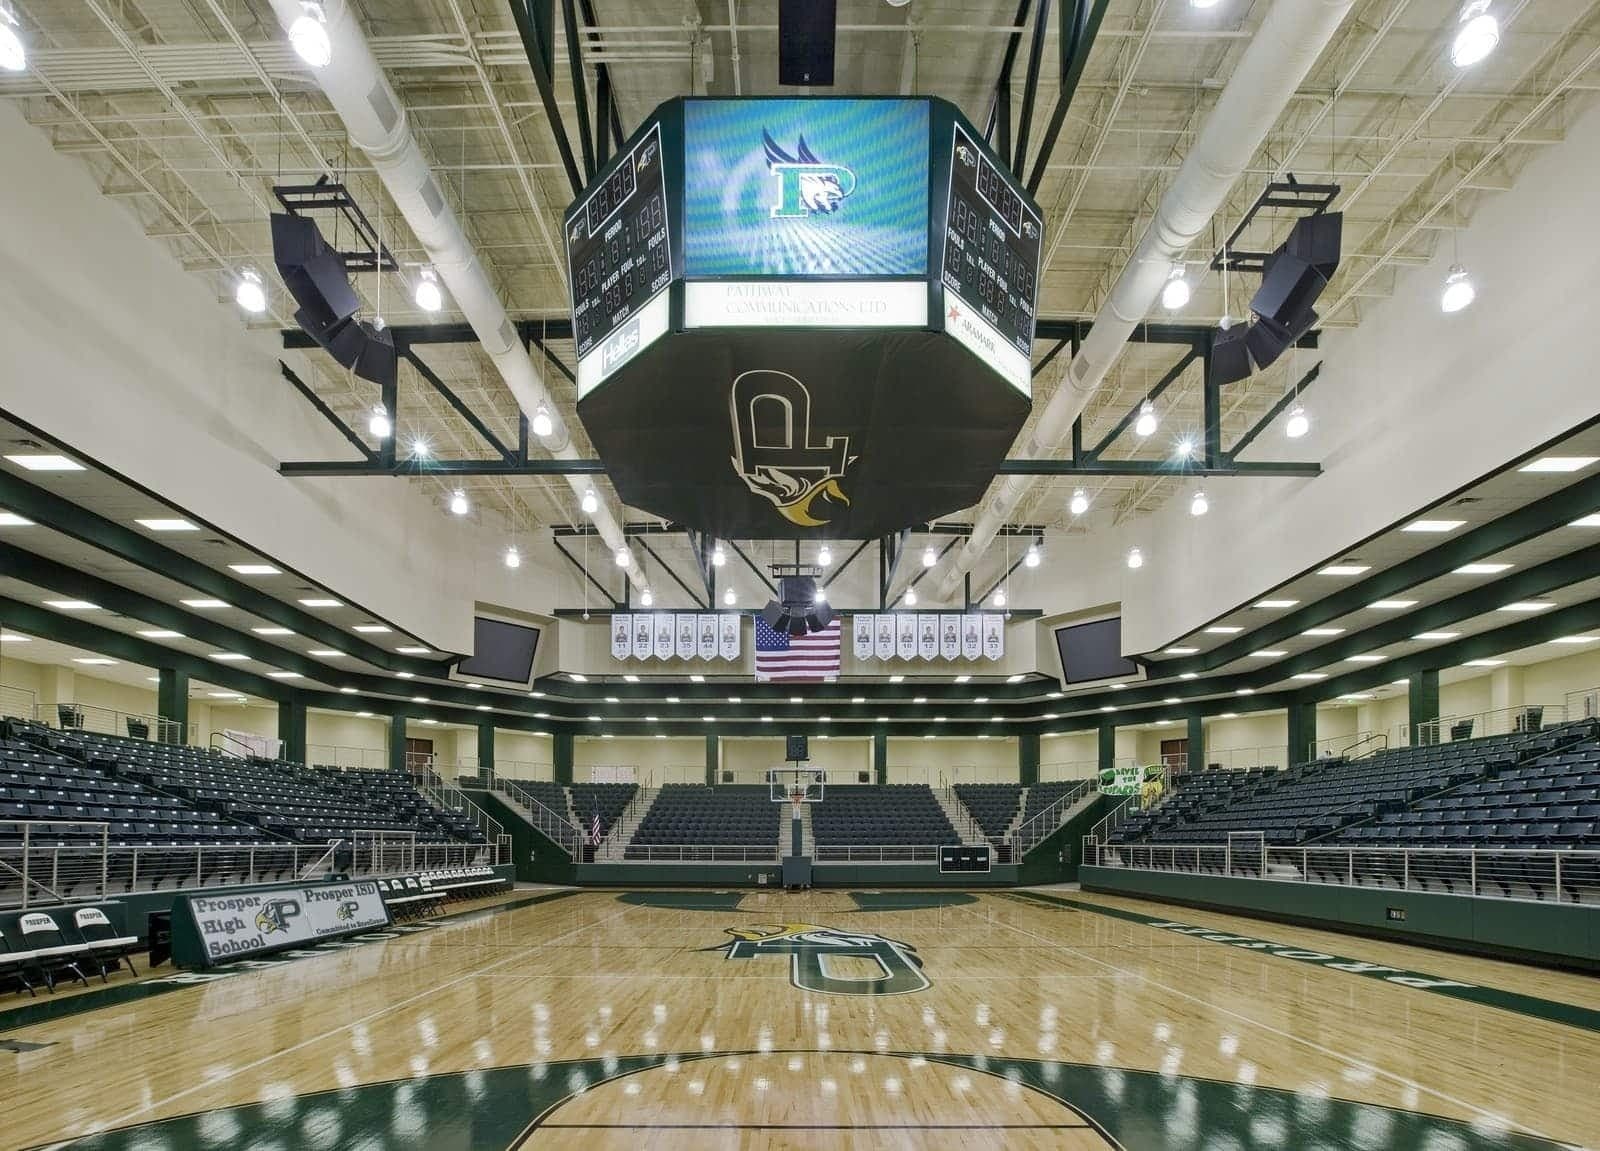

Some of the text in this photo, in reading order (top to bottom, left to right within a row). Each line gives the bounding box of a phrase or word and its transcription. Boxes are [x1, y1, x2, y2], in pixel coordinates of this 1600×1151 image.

[648, 227, 666, 250] FOULS
[601, 257, 634, 293] PLAYER FOUL
[651, 269, 670, 293] SCORE
[944, 269, 961, 293] SCORE
[977, 256, 1008, 294] PLAYER FOUL
[726, 286, 791, 297] PATHWAY
[575, 298, 589, 318] FOULS
[612, 303, 630, 326] MATCH
[981, 303, 999, 326] MATCH
[304, 883, 375, 902] Prosper ISD
[196, 897, 261, 912] Prosper
[24, 918, 51, 926] PROSPER
[80, 912, 102, 920] PROSPER
[202, 917, 246, 934] High
[316, 923, 350, 934] Committed
[209, 934, 266, 956] School
